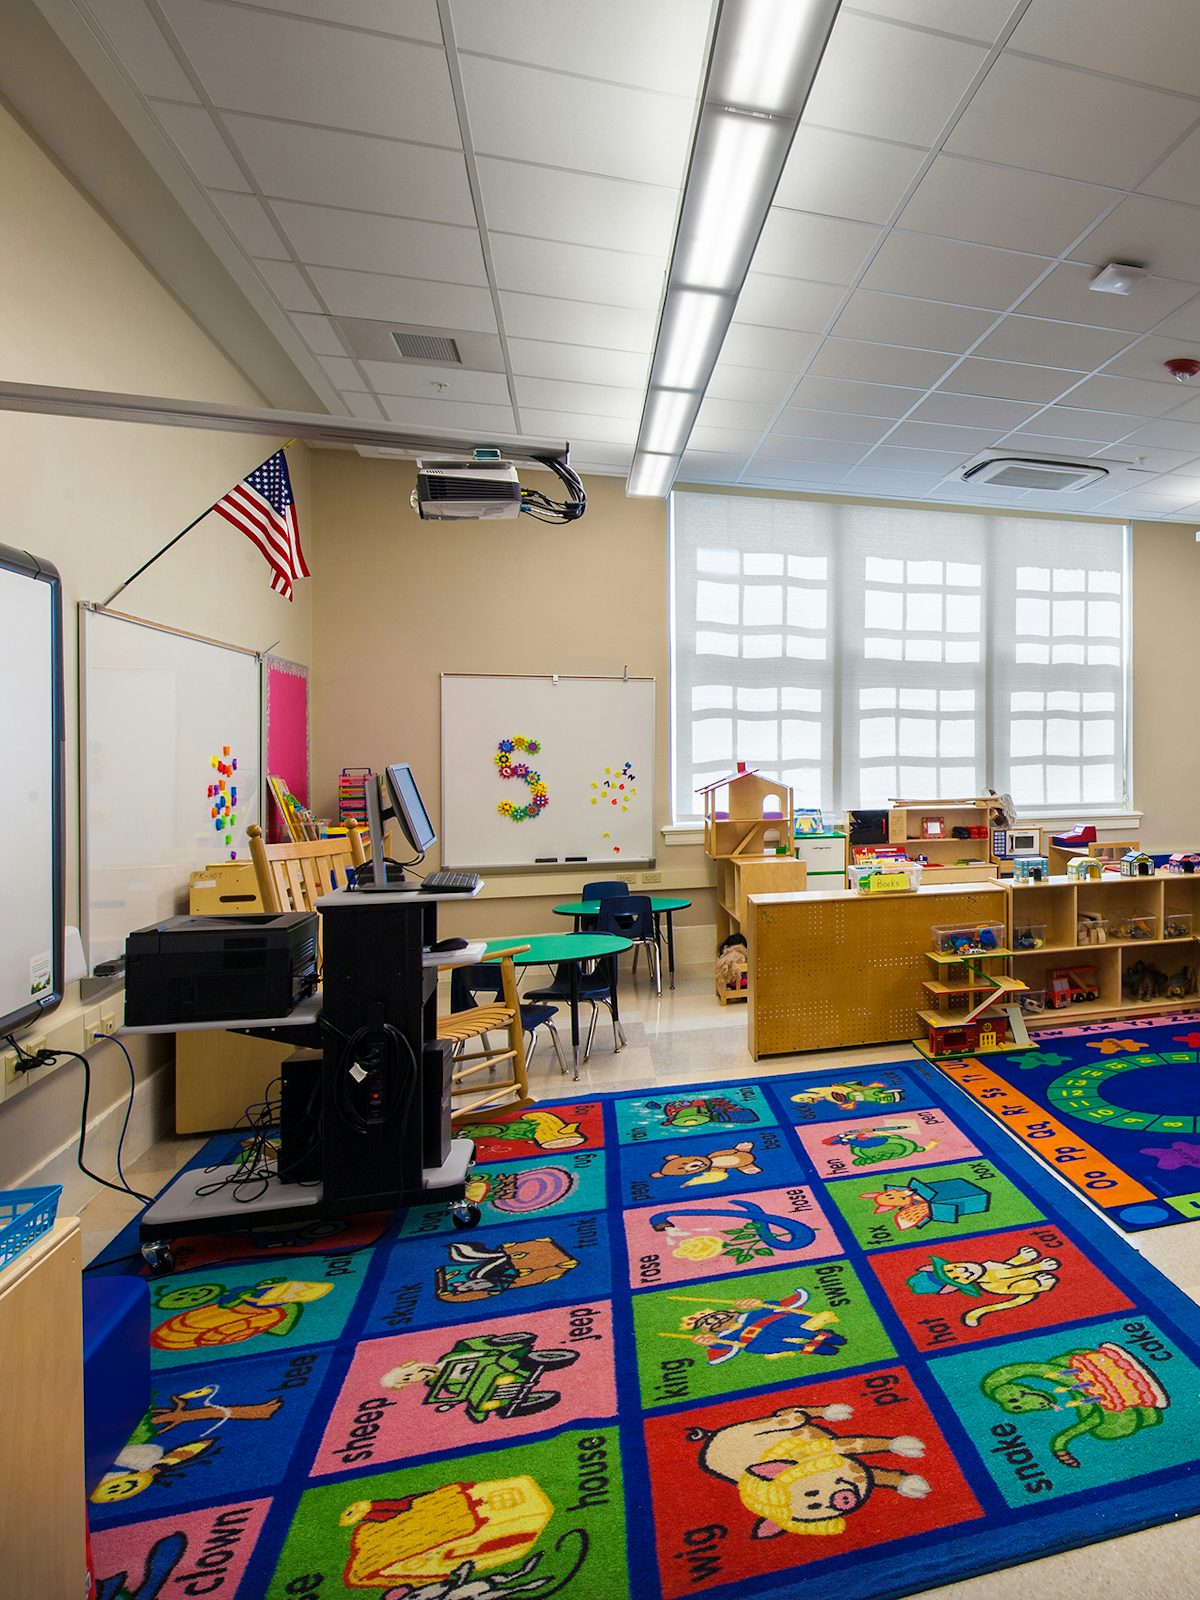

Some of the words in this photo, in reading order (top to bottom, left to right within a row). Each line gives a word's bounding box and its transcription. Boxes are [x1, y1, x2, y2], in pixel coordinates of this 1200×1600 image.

[876, 877, 900, 889] Books
[981, 1086, 1008, 1099] Ss
[917, 1111, 945, 1126] pen
[1001, 1104, 1030, 1117] Rr
[1088, 1109, 1114, 1118] 10
[1025, 1120, 1056, 1140] Qq
[572, 1152, 598, 1170] rug
[826, 1158, 850, 1176] hen
[1054, 1146, 1088, 1164] Pp
[968, 1161, 997, 1181] box
[1083, 1170, 1119, 1190] Oo
[629, 1180, 658, 1201] pear
[786, 1188, 814, 1214] hose
[409, 1210, 450, 1236] bug
[572, 1216, 599, 1249] trunk
[867, 1224, 894, 1246] fox
[1028, 1230, 1065, 1250] cat
[639, 1253, 663, 1285] rose
[813, 1264, 852, 1309] swing
[380, 1281, 424, 1327] skunk
[559, 1306, 603, 1345] jeep
[917, 1316, 961, 1347] hat
[1122, 1320, 1174, 1363] cake
[268, 1352, 319, 1391] bee
[654, 1357, 696, 1402] king
[860, 1373, 910, 1407] pig
[332, 1396, 399, 1465] sheep
[989, 1421, 1054, 1495] snake
[565, 1434, 611, 1512] house
[173, 1506, 254, 1598] clown
[673, 1522, 729, 1584] wig
